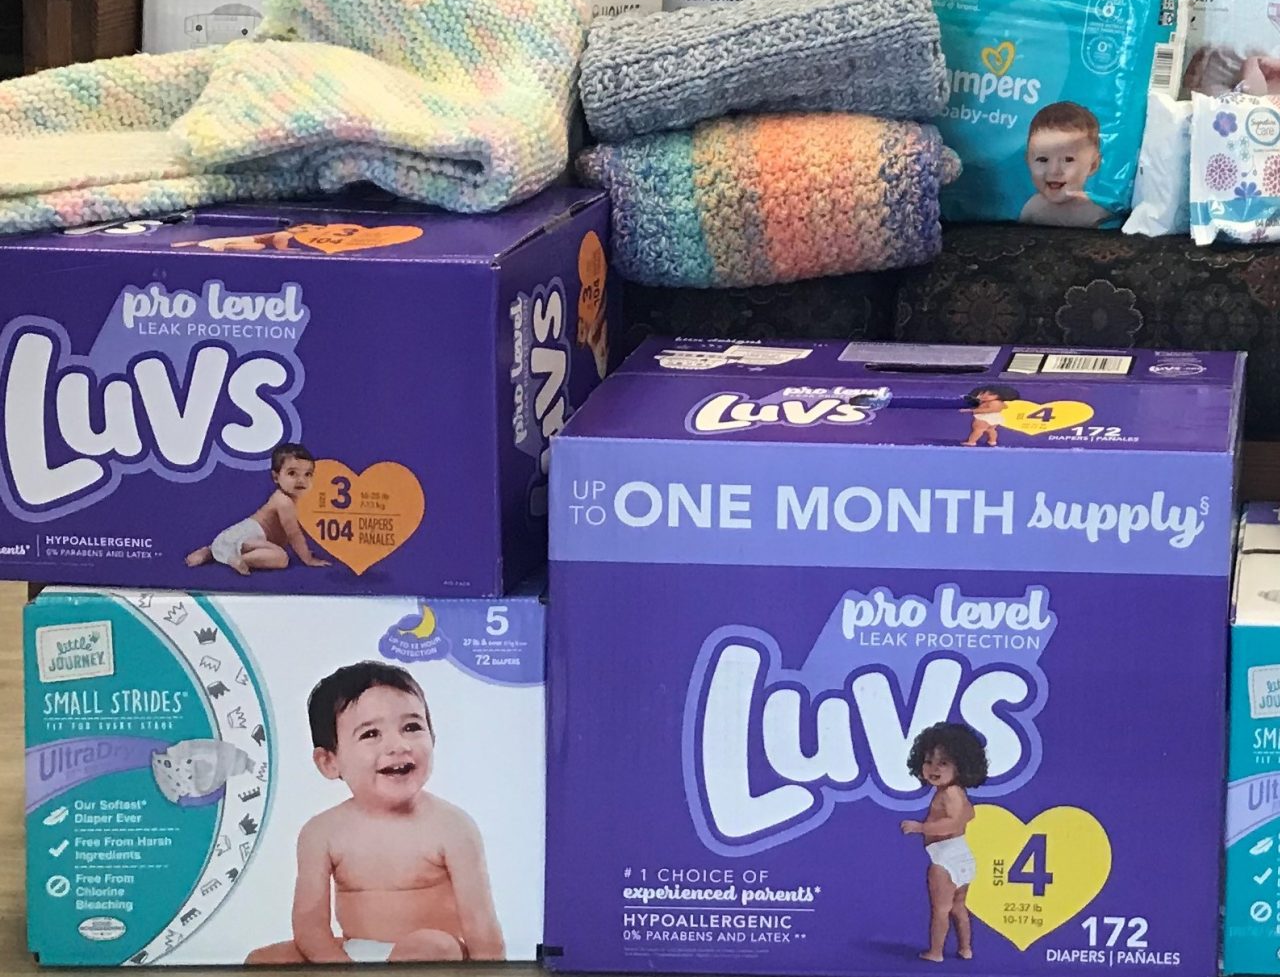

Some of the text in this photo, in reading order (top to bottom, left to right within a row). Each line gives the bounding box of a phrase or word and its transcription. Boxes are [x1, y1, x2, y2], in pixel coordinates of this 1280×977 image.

[1256, 126, 1275, 137] Care
[122, 282, 304, 327] pro level
[139, 321, 296, 340] LEAK PROTECTION
[5, 332, 288, 506] Luvs
[695, 394, 870, 431] Luvs
[1027, 407, 1055, 423] 4
[1071, 426, 1122, 437] 172
[330, 476, 352, 509] 3
[572, 480, 607, 501] UP
[569, 505, 606, 526] TO
[613, 480, 752, 530] ONE
[776, 485, 1014, 536] MONTH
[315, 517, 394, 542] 104 DIAPERS
[45, 535, 153, 548] HYPOALLERGENIC
[126, 550, 152, 559] LATEX
[486, 606, 509, 635] 5
[842, 588, 1050, 639] pro level
[56, 636, 93, 656] little
[859, 631, 1040, 650] LEAK PROTECTION
[391, 645, 437, 657] PROTECTION
[475, 654, 490, 665] 72
[49, 651, 105, 672] JOURNEY
[43, 689, 103, 715] SMALL
[702, 644, 1028, 838] Luvs
[74, 800, 96, 810] Our
[74, 813, 142, 825] Diaper Ever
[74, 836, 172, 847] Free From Harsh
[75, 850, 141, 863] Ingredients
[1008, 834, 1053, 896] 4
[75, 874, 134, 884] Free From
[657, 868, 769, 883] CHOICE OF
[993, 859, 1004, 886] SIZE
[75, 887, 125, 897] Chlorine
[623, 884, 738, 904] experienced
[75, 900, 134, 912] Bleaching
[1003, 903, 1031, 912] 22-37
[623, 913, 793, 929] HYPOALLERGENIC
[1003, 915, 1044, 927] 10-17 kg
[623, 930, 790, 943] 0% PARABENS AND LATEX
[1081, 916, 1149, 948] 172
[1046, 948, 1181, 965] DIAPERS PAÑALES
